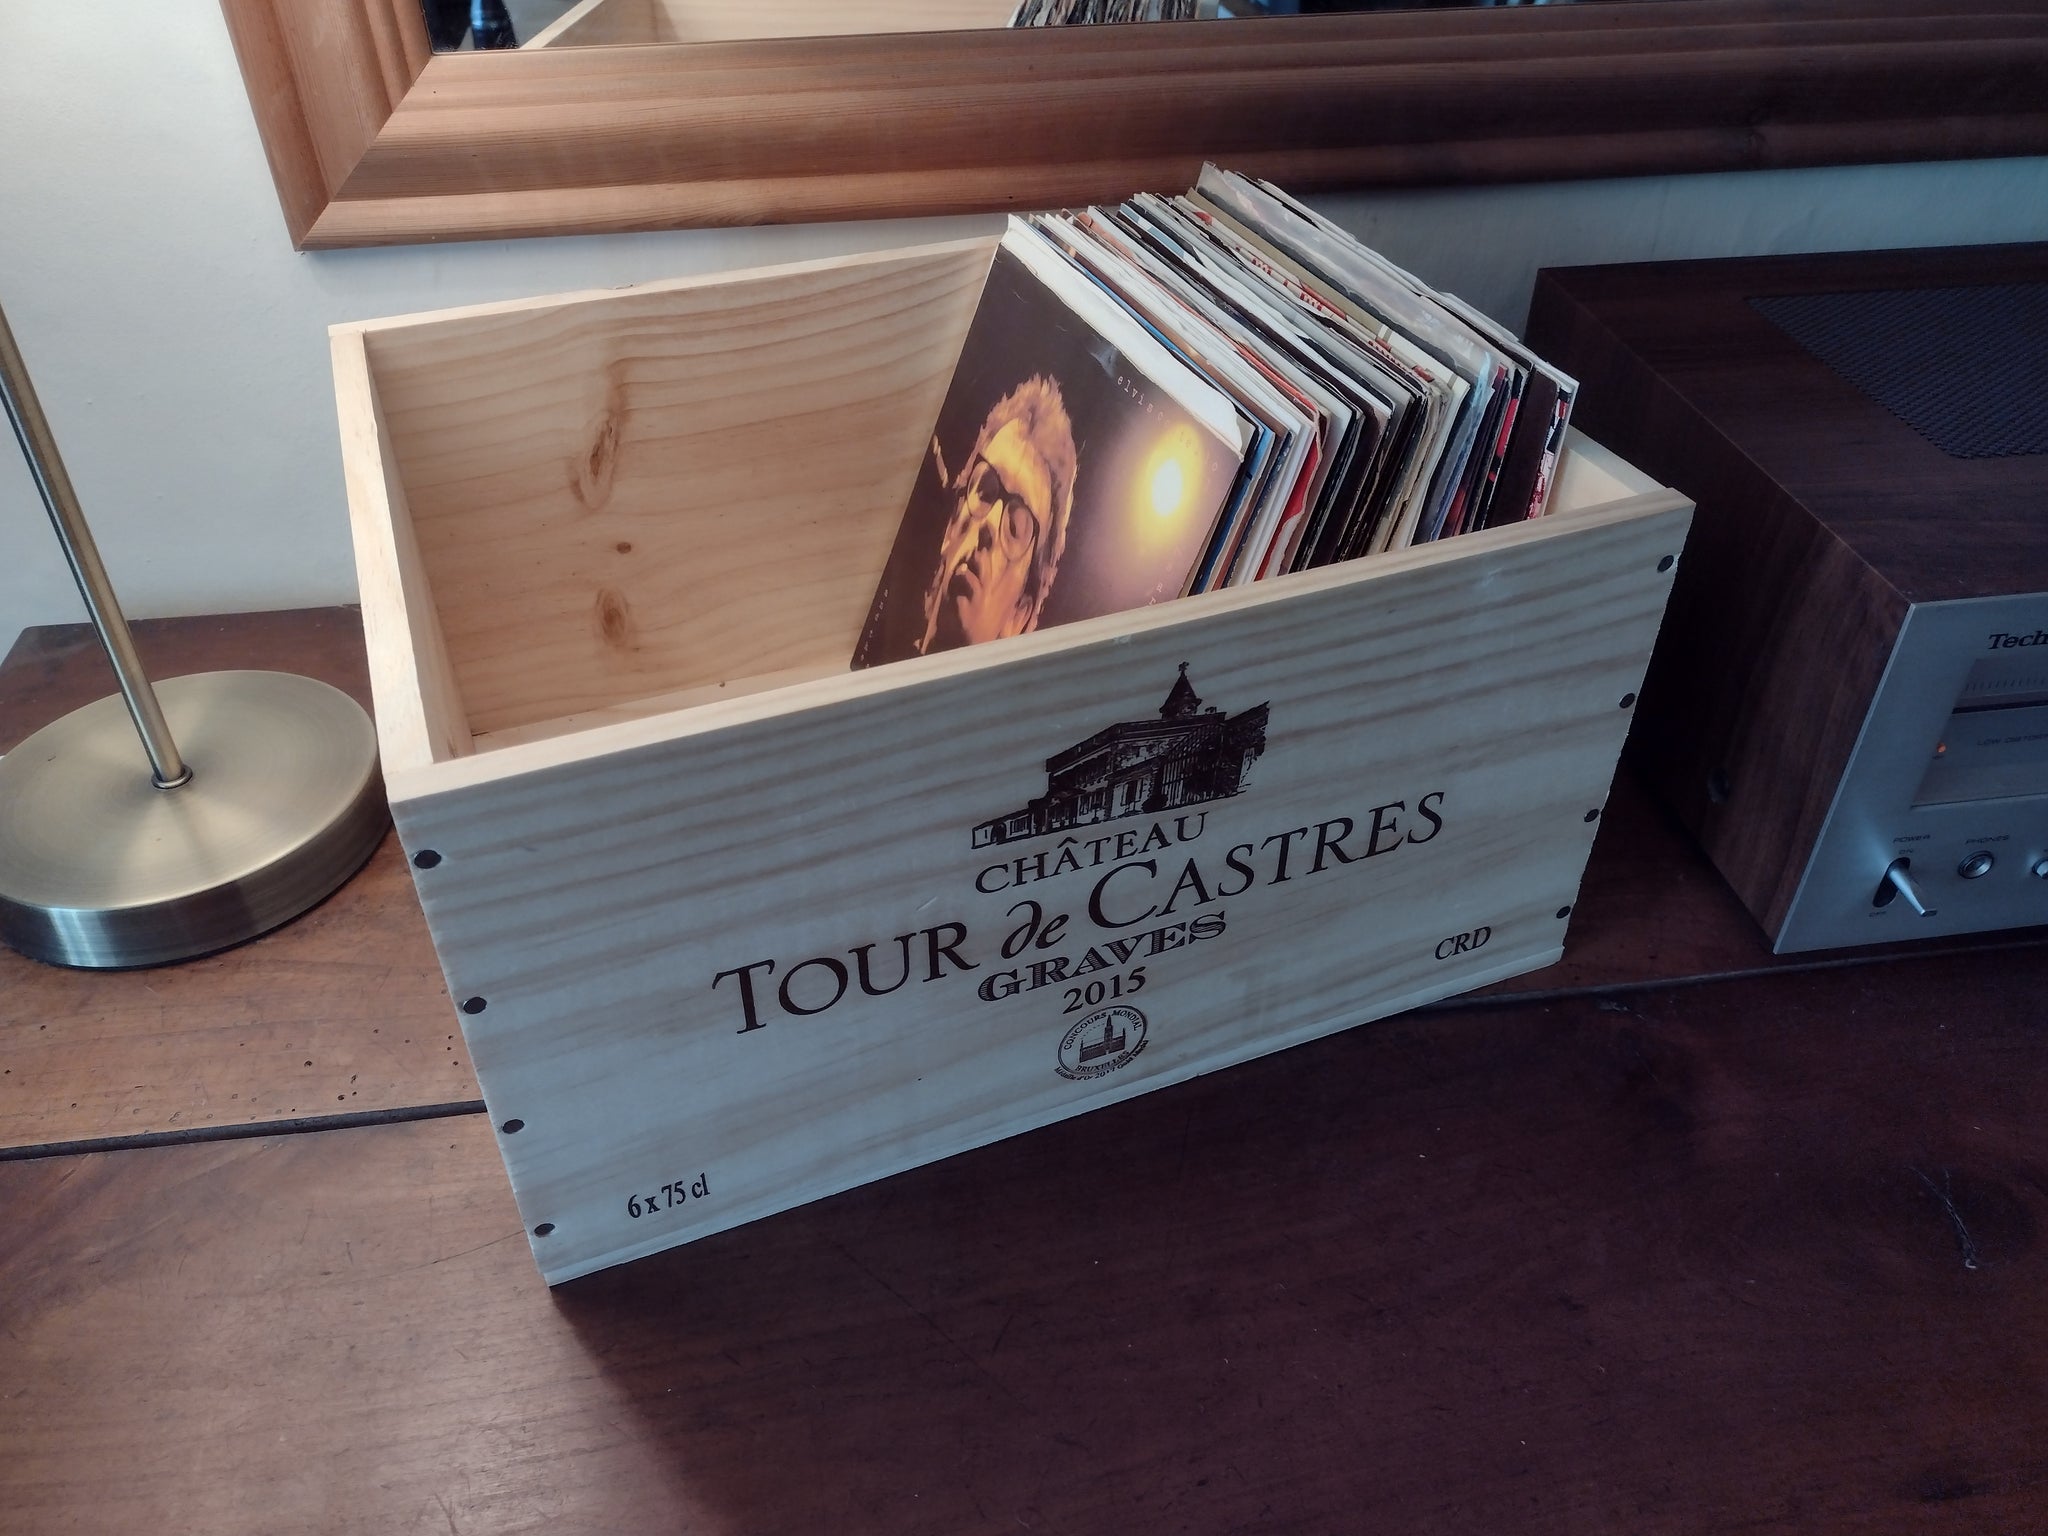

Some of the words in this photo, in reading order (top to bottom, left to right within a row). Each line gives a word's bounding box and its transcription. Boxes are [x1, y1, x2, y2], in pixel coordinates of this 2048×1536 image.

[1117, 375, 1154, 413] elvis
[1988, 630, 2048, 650] Tech
[974, 811, 1211, 894] CHÂTEAU
[711, 921, 981, 1035] TOUR
[1000, 899, 1070, 960] de
[1087, 791, 1446, 929] CASTRES
[977, 910, 1227, 1002] GRAVES
[1434, 926, 1492, 960] CRD
[1062, 966, 1147, 1015] 2015
[1063, 1011, 1107, 1050] CONCOURS
[1111, 1009, 1143, 1032] MONDIAL
